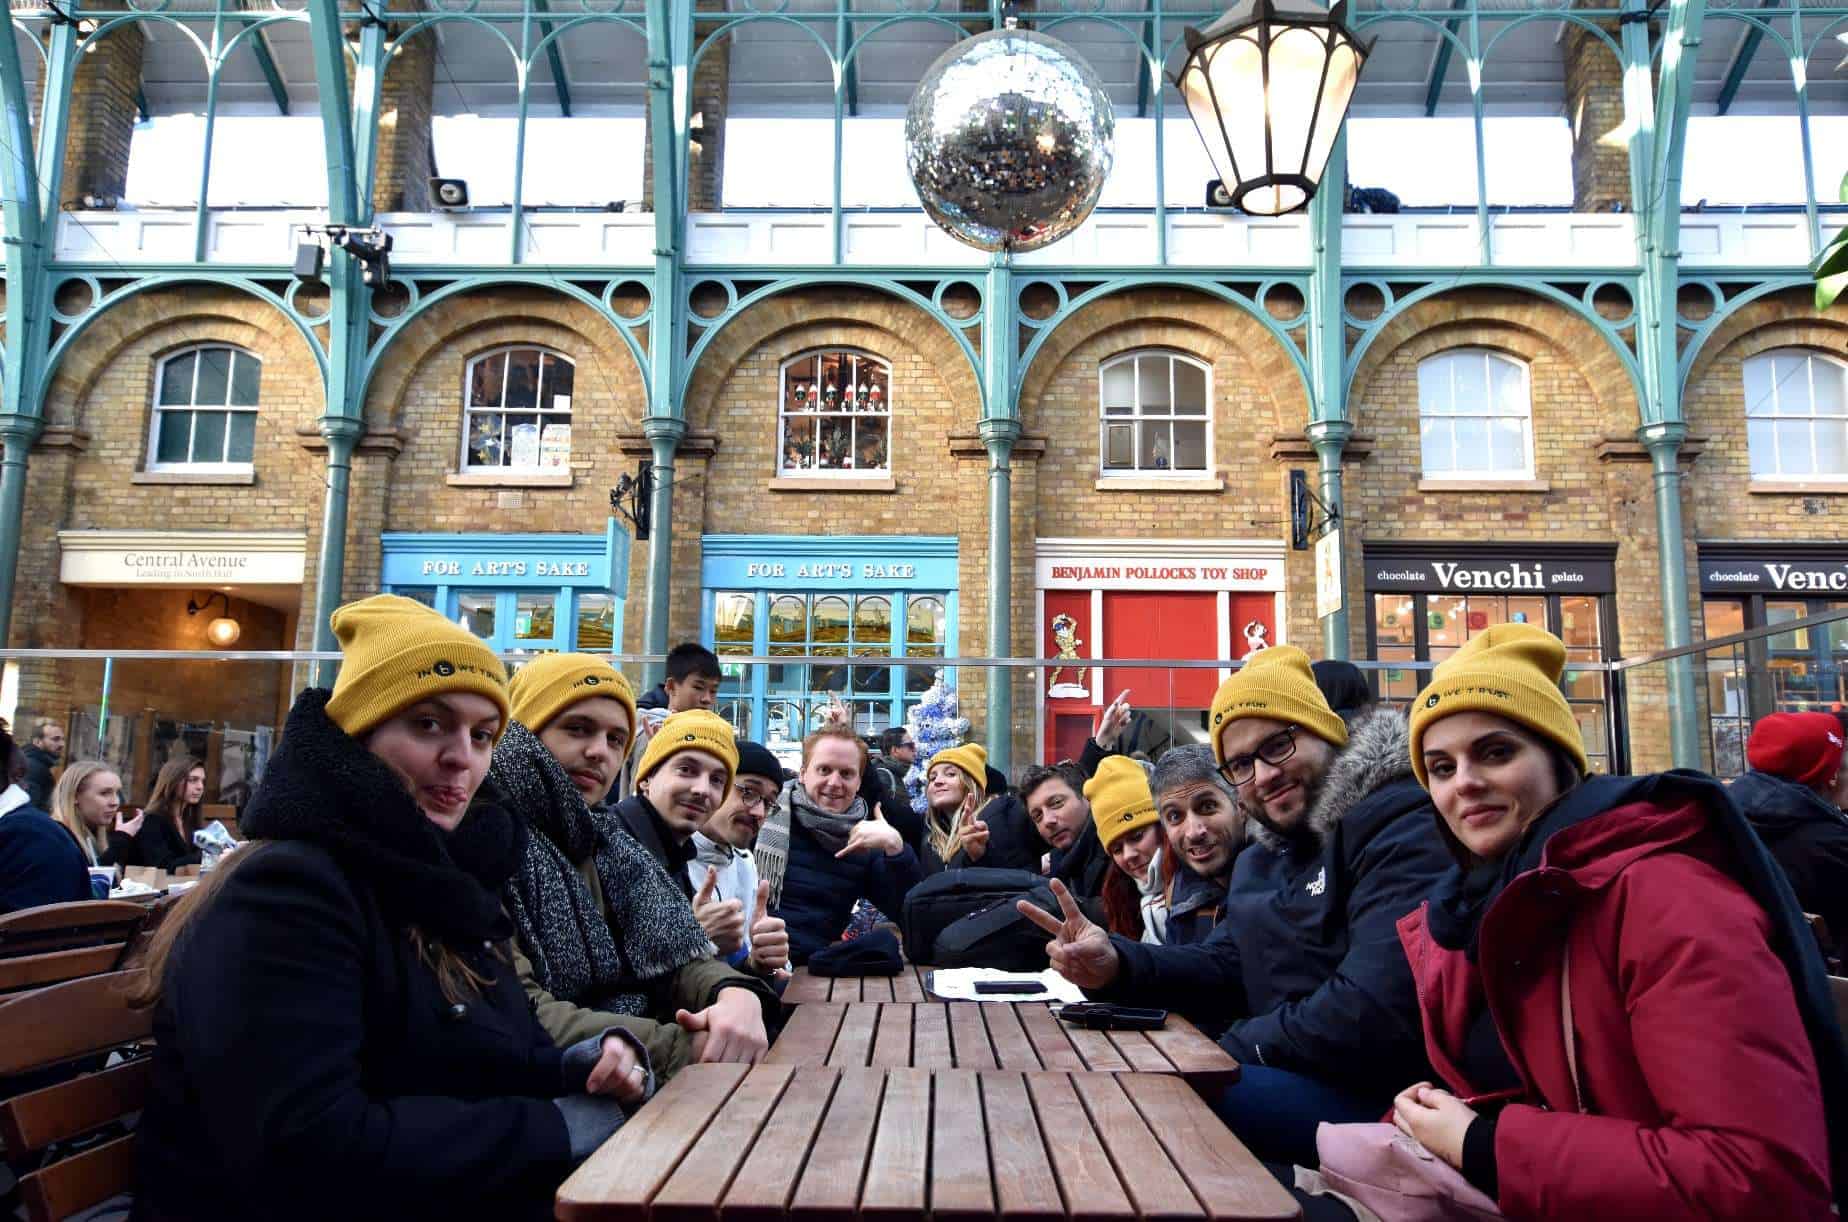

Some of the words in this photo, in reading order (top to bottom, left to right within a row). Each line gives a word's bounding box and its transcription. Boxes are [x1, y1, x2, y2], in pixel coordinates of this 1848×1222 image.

[124, 552, 183, 567] Central
[187, 552, 248, 568] Avenue
[422, 560, 462, 576] FOR
[472, 560, 528, 576] ART'S
[536, 560, 589, 577] SAKE
[747, 563, 785, 578] FOR
[797, 563, 853, 579] ART'S
[863, 564, 914, 579] SAKE
[1051, 566, 1121, 582] BENJAMIN
[1201, 567, 1228, 581] TOY
[1232, 568, 1268, 581] SHOP
[1376, 570, 1426, 582] chocolate
[1431, 562, 1546, 589] Venchi
[1551, 572, 1584, 584] gelato
[1709, 570, 1760, 582] chocolate
[1763, 563, 1848, 590] Venc
